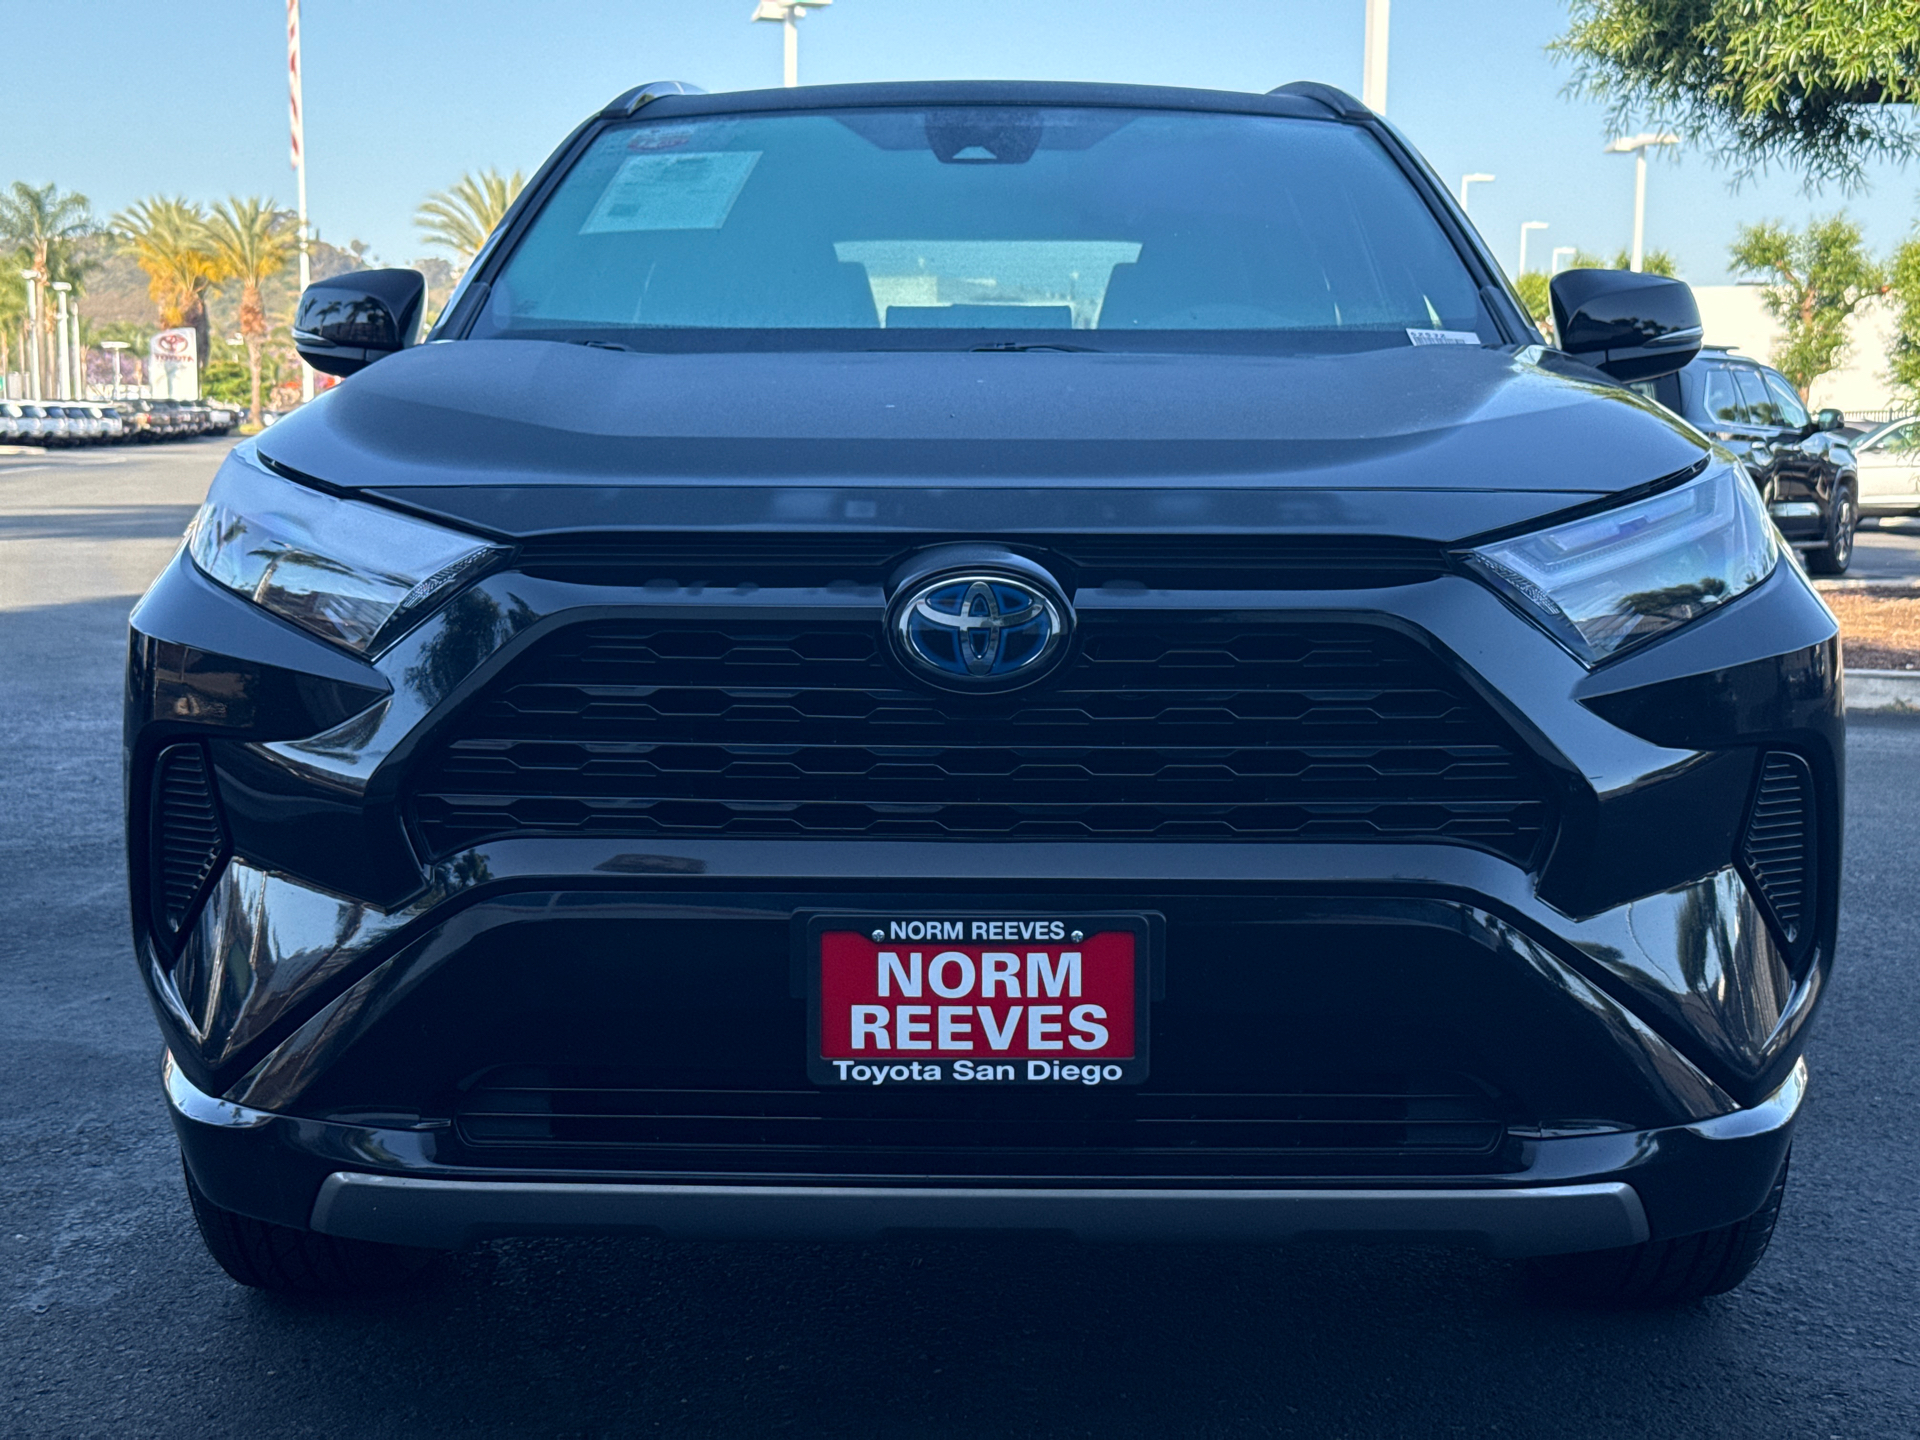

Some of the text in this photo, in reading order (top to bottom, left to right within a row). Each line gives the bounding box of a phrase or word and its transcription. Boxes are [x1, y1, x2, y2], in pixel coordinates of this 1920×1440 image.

[154, 353, 195, 362] TOYOTA
[891, 921, 1064, 939] NORM REEVES
[878, 952, 1081, 998] NORM
[851, 1004, 1108, 1050] REEVES
[833, 1060, 1122, 1085] Toyota San Diego
